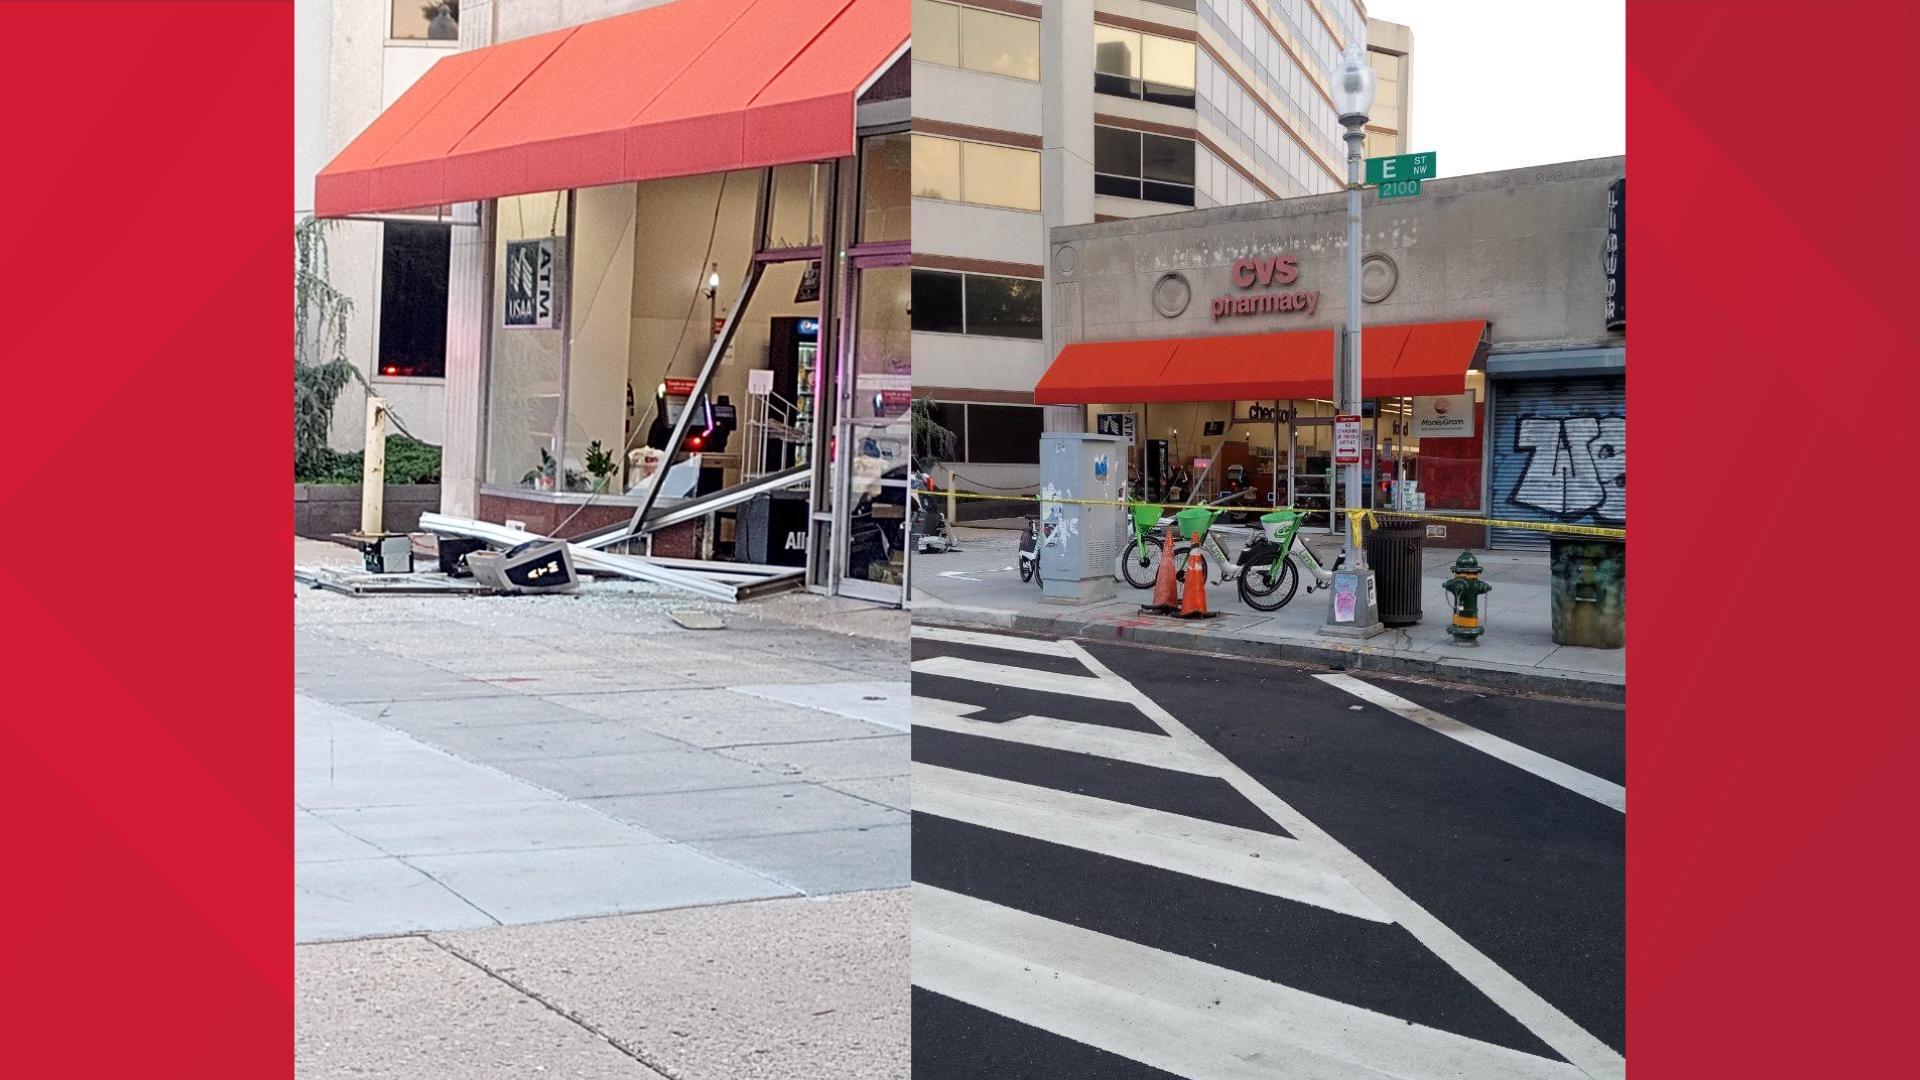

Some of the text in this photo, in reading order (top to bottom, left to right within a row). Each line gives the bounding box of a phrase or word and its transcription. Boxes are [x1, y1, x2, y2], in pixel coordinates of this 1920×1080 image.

[1383, 159, 1396, 178] E
[1414, 155, 1426, 165] ST
[1413, 165, 1427, 175] NW
[1383, 181, 1416, 195] 2100
[1232, 255, 1298, 288] CVS
[539, 247, 551, 318] ATM
[509, 299, 532, 317] USAA
[1211, 289, 1320, 320] pharmacy
[1421, 418, 1464, 427] MoneyGram
[527, 560, 560, 579] ATM
